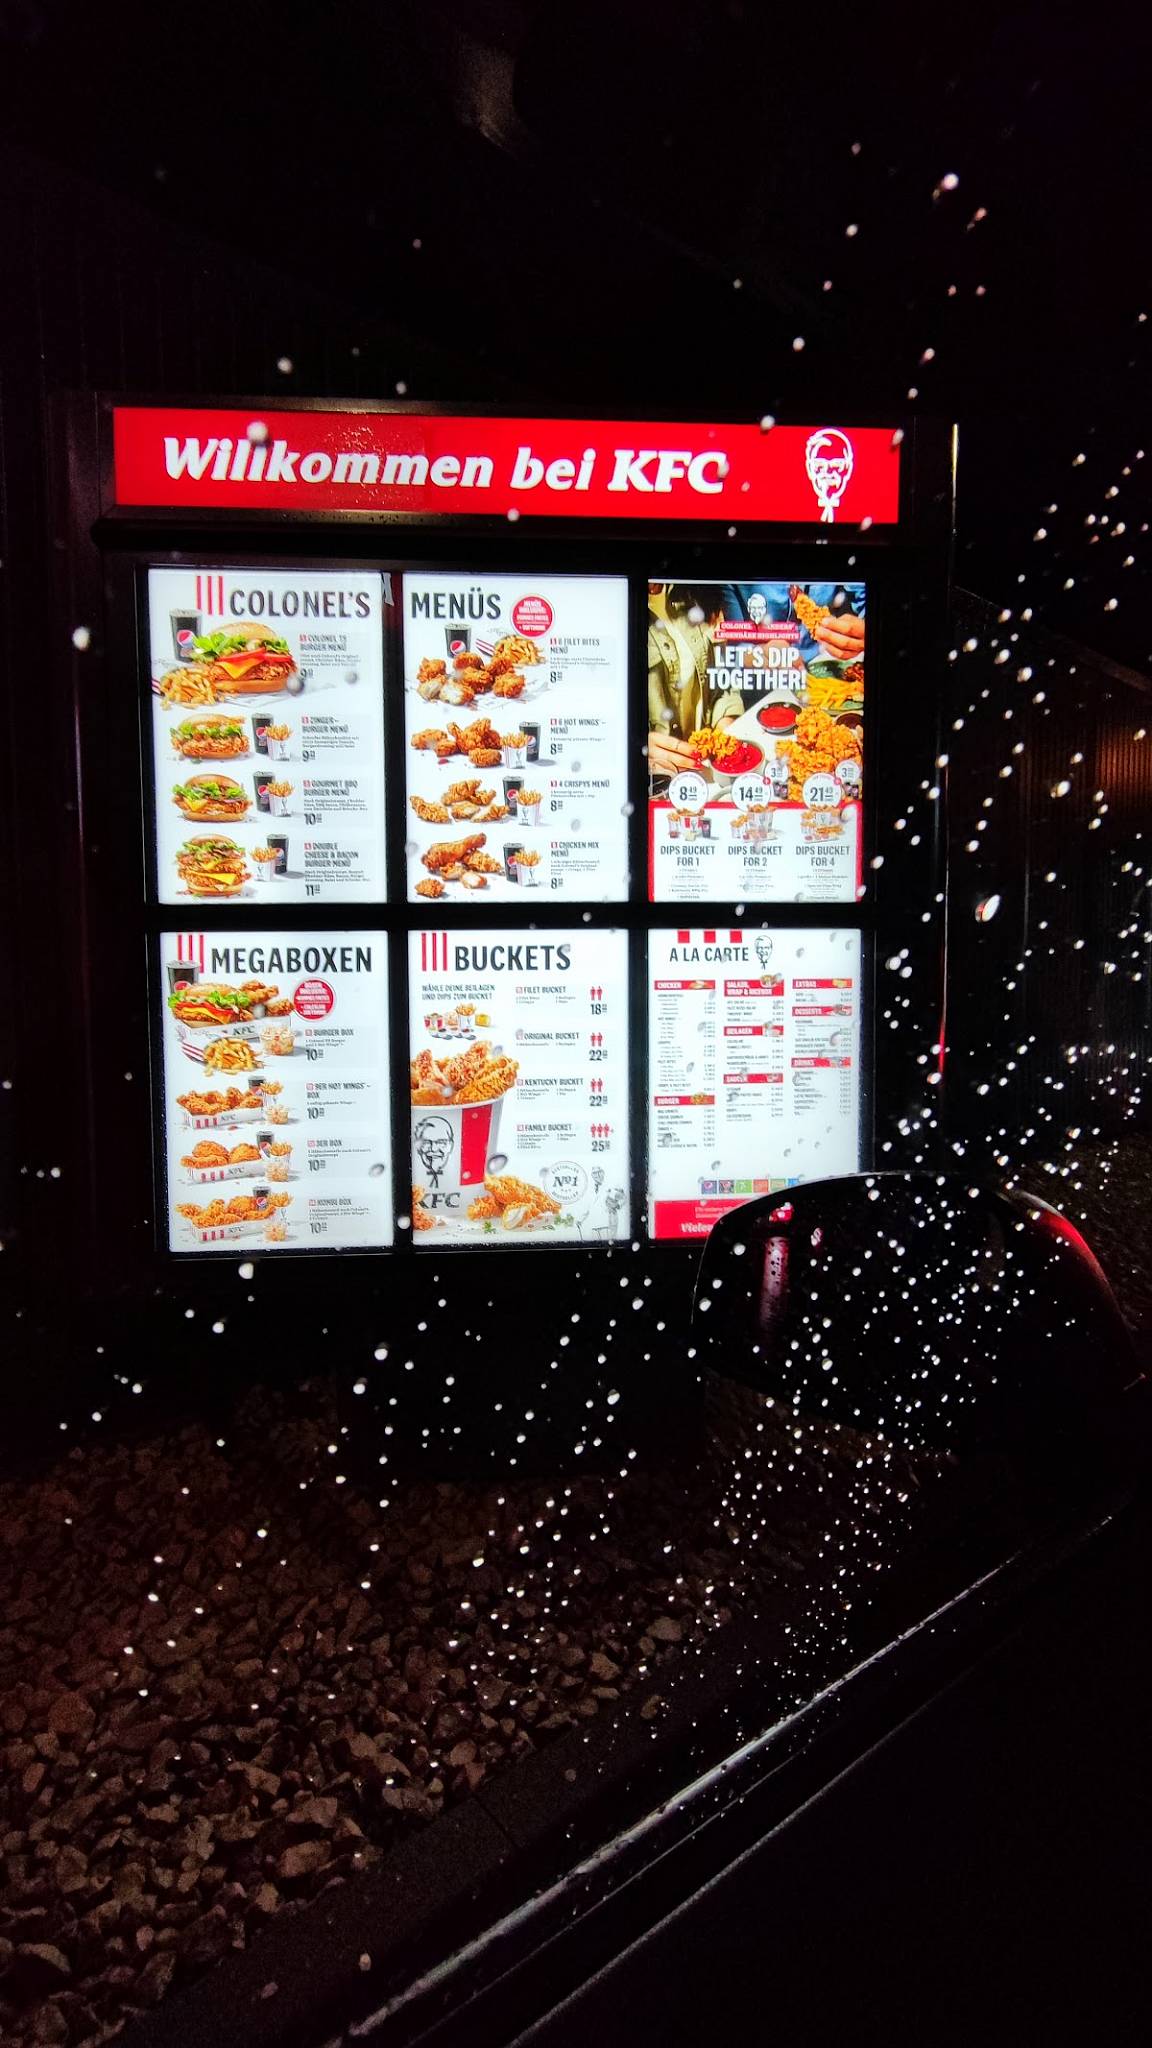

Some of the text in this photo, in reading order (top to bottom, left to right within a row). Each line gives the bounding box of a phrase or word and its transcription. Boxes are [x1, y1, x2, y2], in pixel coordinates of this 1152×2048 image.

[164, 437, 728, 494] Willkommen bei KFC
[229, 589, 370, 618] COLONEL'S
[411, 587, 501, 619] MENÜS
[550, 645, 568, 654] MENÜ
[715, 646, 799, 668] LET'S DIP
[706, 668, 807, 690] TOGETHER!
[660, 845, 715, 855] DIPS BUCKET
[728, 845, 748, 855] DIPS
[796, 846, 850, 855] DIPS BUCKET
[677, 857, 694, 866] FOR
[743, 857, 760, 866] FOR
[810, 857, 827, 866] FOR
[455, 944, 571, 971] BUCKETS
[669, 947, 749, 962] A LA CARTE
[211, 947, 372, 974] MEGABOXEN
[542, 986, 566, 994] BUCKET
[525, 1078, 557, 1086] KENTUCKY
[525, 1124, 546, 1132] FAMILY
[416, 1192, 460, 1210] KFC
